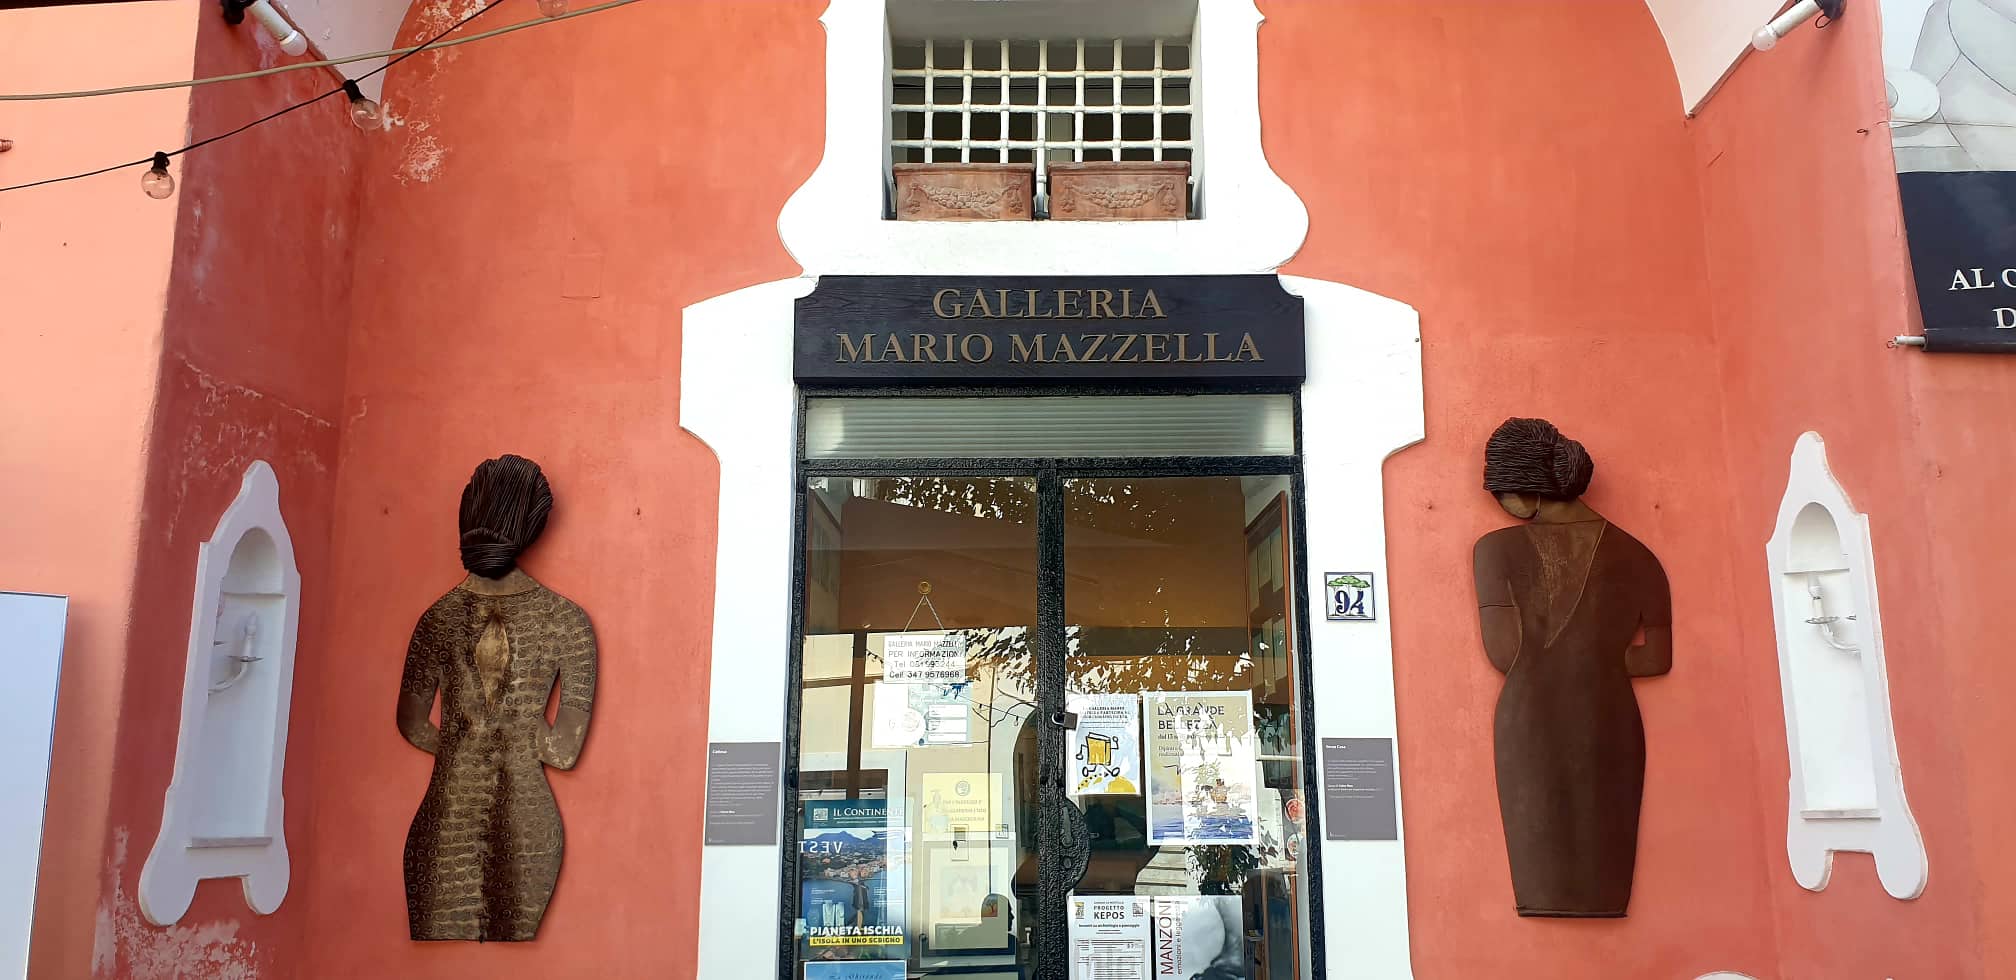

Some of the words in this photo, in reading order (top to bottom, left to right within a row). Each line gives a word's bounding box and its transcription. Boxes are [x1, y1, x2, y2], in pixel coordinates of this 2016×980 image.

[1947, 268, 1995, 290] AL
[932, 288, 1167, 319] GALLERIA
[835, 332, 994, 364] MARIO
[1008, 331, 1264, 363] MAZZELLA
[1335, 590, 1365, 614] 94
[888, 650, 904, 658] PER
[1157, 704, 1174, 716] LA
[1158, 719, 1218, 730] BEEZA
[833, 808, 841, 817] IL
[1093, 911, 1125, 920] KEPOS
[810, 926, 861, 936] PIANETA
[864, 925, 903, 935] ISCHIA
[1159, 901, 1174, 975] MANZONI
